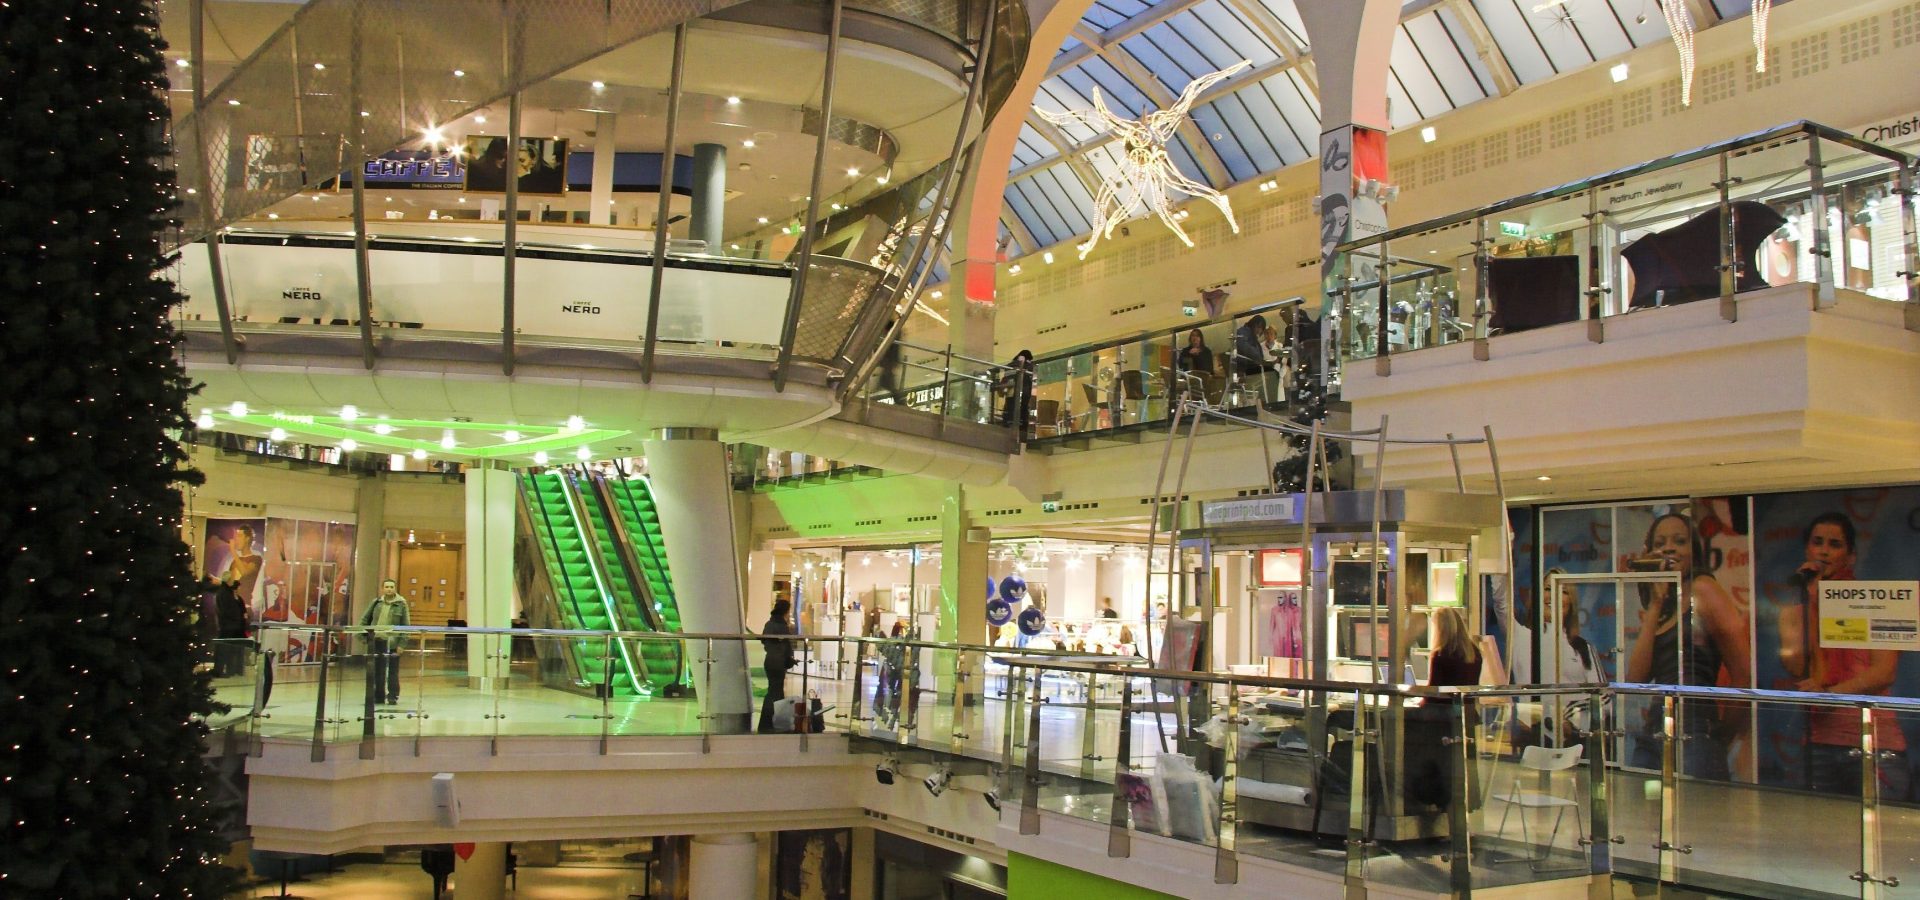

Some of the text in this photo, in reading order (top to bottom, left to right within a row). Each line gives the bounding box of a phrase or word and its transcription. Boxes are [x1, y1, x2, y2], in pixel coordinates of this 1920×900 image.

[1862, 116, 1920, 143] Christ
[1609, 181, 1683, 204] Platinum Jewellery
[282, 291, 321, 300] NERO
[562, 305, 600, 314] NERO
[1825, 588, 1913, 600] SHOPS TO LET
